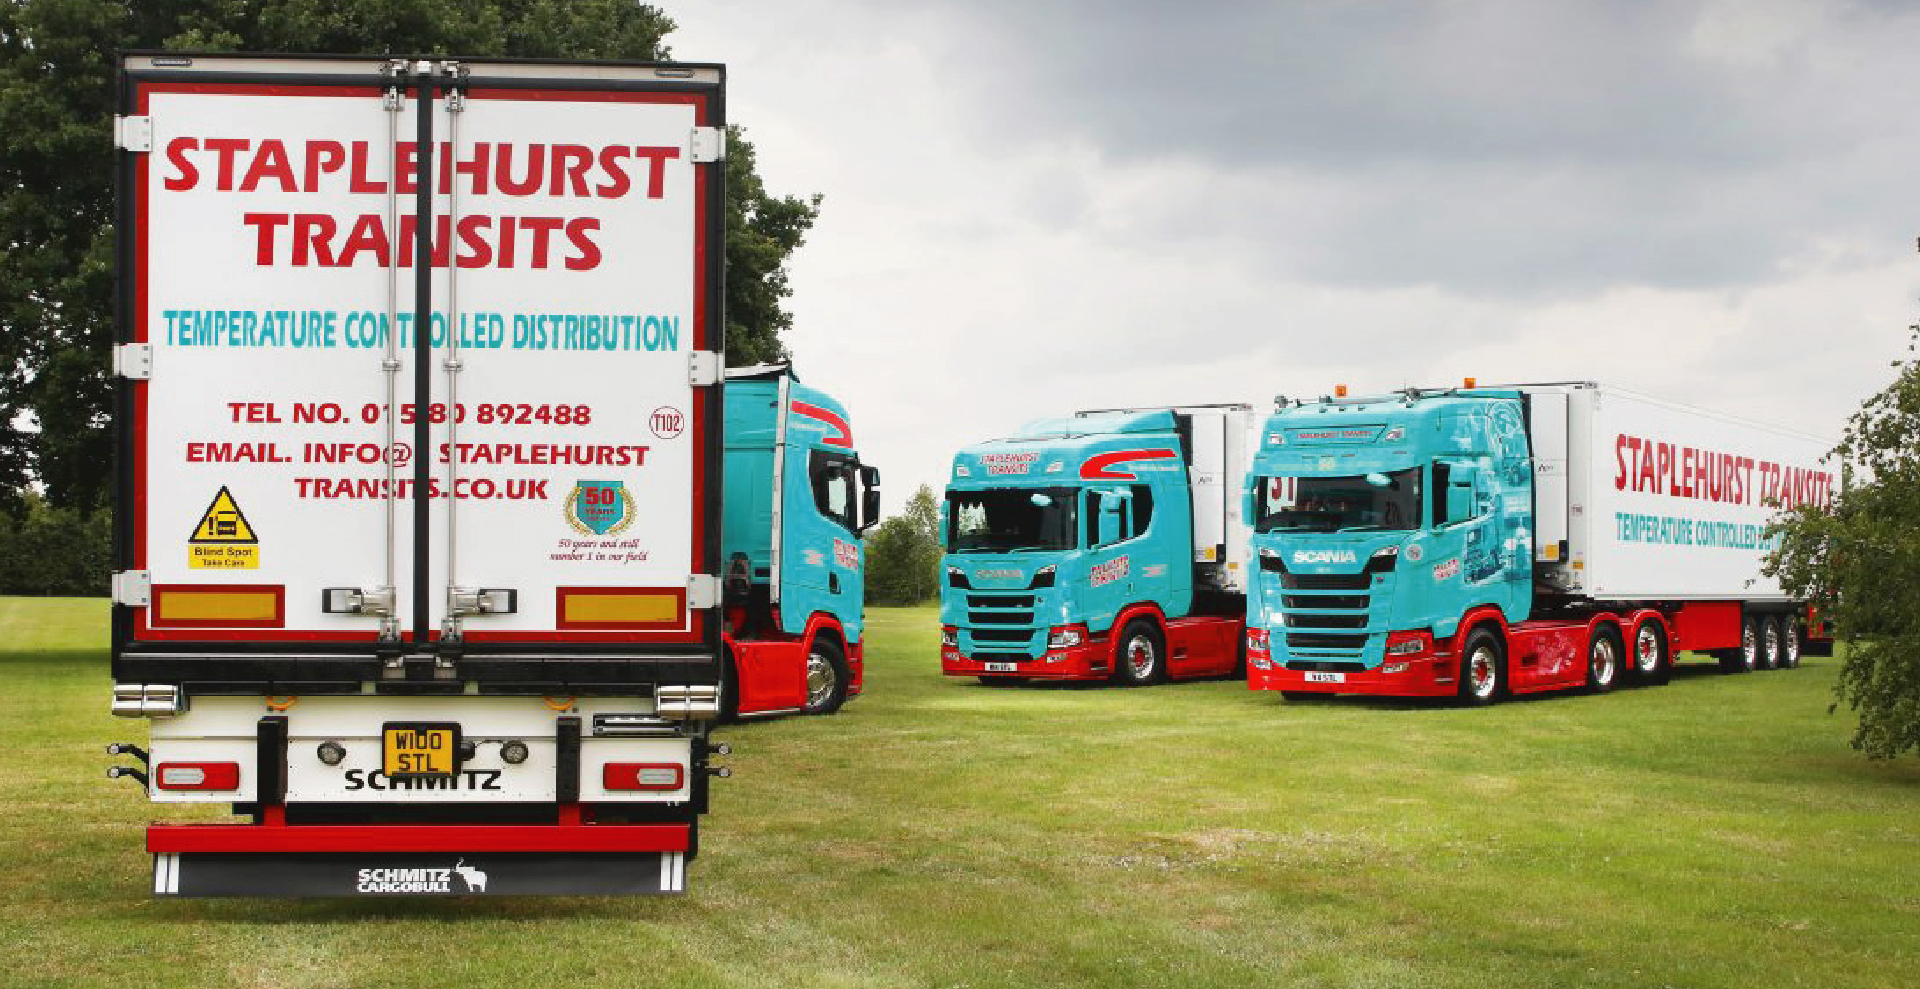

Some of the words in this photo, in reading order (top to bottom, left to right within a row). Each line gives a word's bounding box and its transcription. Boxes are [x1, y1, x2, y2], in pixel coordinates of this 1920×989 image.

[164, 136, 679, 200] STAPLEHURST
[243, 212, 602, 271] TRANSITS
[163, 310, 337, 348] TEMPERATURE
[513, 314, 679, 352] DISTRIBUTION
[227, 403, 281, 425] TEL
[292, 403, 349, 425] NO.
[476, 403, 592, 425] 892488
[653, 412, 681, 433] T102
[185, 442, 292, 463] EMAIL.
[439, 443, 650, 466] STAPLEHURST
[1614, 433, 1754, 505] STAPLEHURST
[586, 486, 615, 505] 50
[1614, 511, 1693, 546] TEMPERATURE
[1695, 520, 1756, 550] CONTROLLED
[194, 546, 223, 556] Blind
[227, 546, 251, 558] Spot
[558, 538, 571, 548] 50
[572, 540, 598, 553] years
[600, 538, 618, 548] and
[203, 559, 223, 567] Take
[225, 559, 245, 567] Care
[549, 551, 584, 561] number
[595, 552, 606, 561] in
[624, 550, 649, 565] field
[1293, 550, 1356, 564] SCANIA
[395, 732, 442, 750] W100
[398, 753, 439, 771] STL
[344, 768, 502, 790] SCHMITZ
[358, 868, 451, 881] SCHMITZ
[356, 881, 451, 893] CARGOBULL
